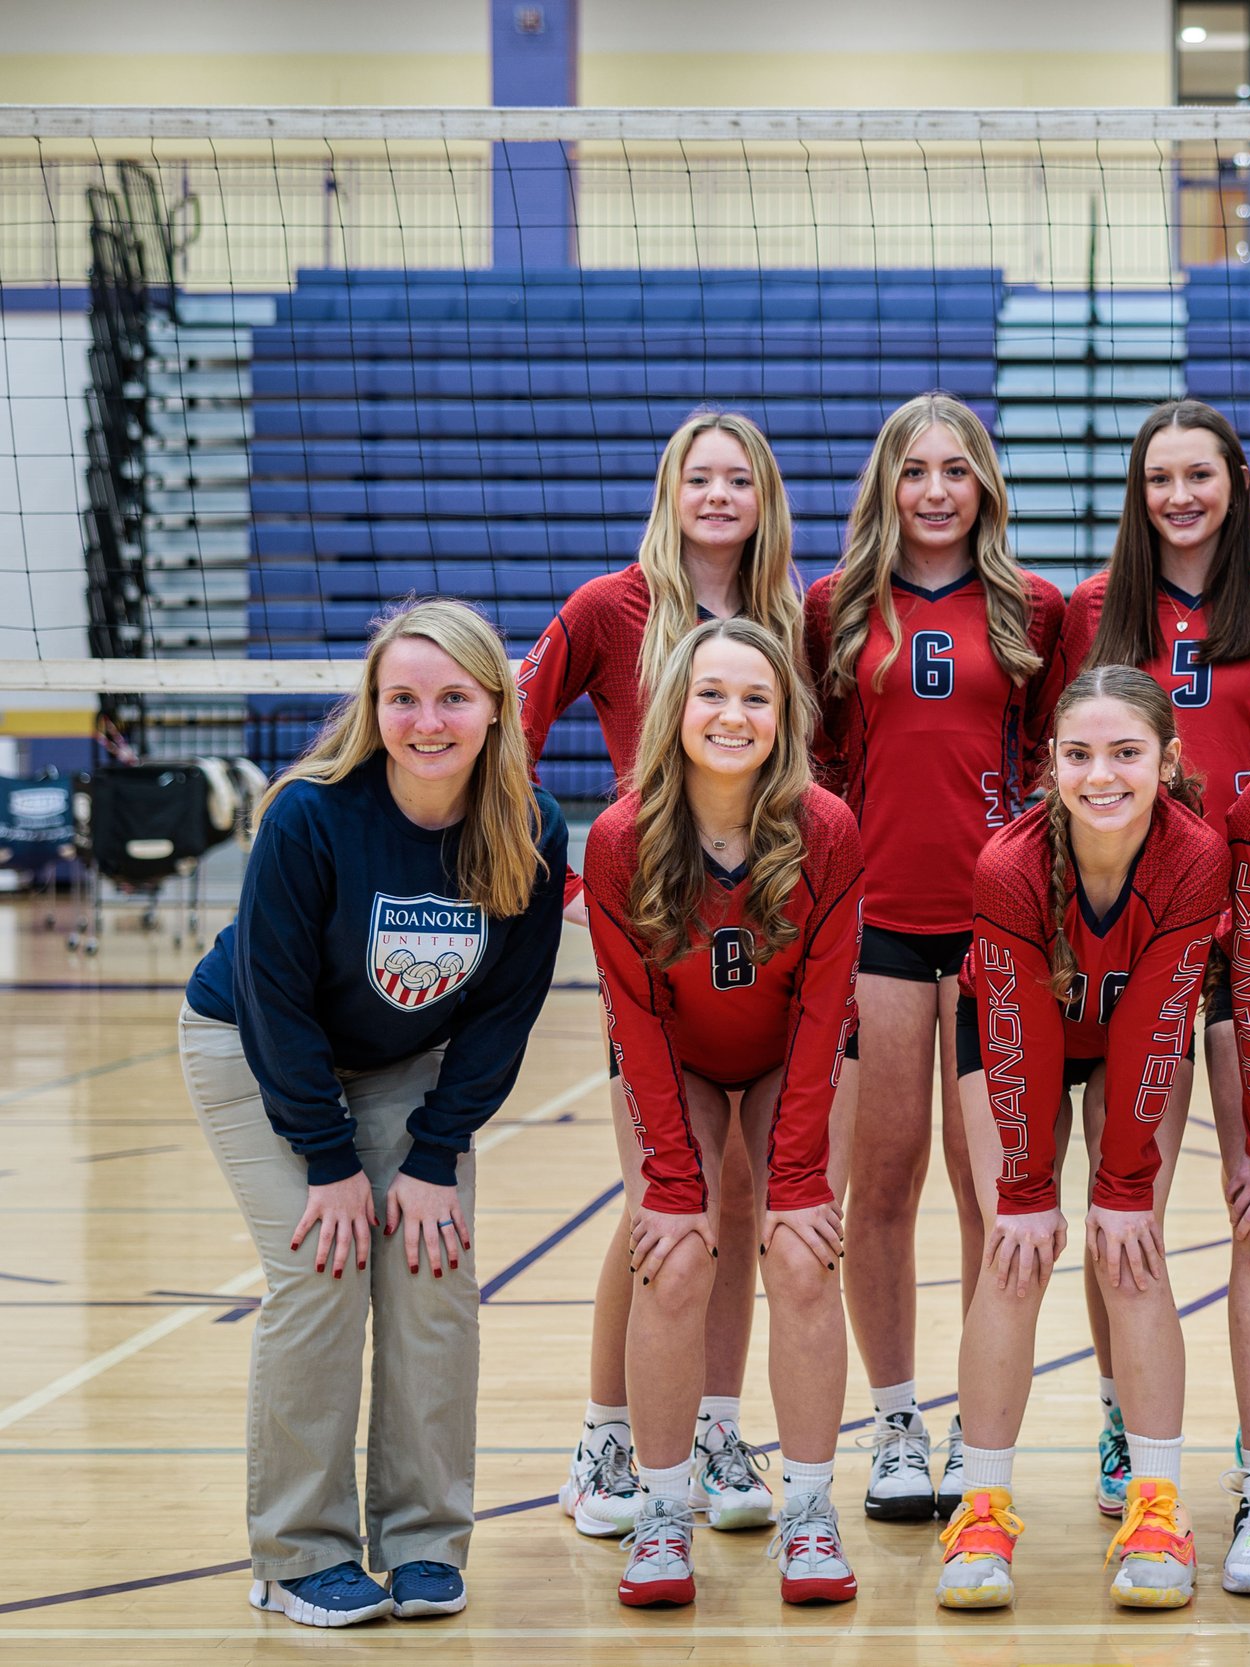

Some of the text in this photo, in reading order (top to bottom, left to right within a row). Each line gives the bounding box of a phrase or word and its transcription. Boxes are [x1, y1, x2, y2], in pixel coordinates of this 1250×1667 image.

[911, 630, 954, 699] 6
[1171, 639, 1213, 709] 5
[382, 935, 475, 948] UNITED
[384, 910, 476, 928] ROANOKE
[711, 926, 756, 991] 8
[978, 937, 1030, 1184] ROANOKE
[1134, 933, 1214, 1124] UNITED
